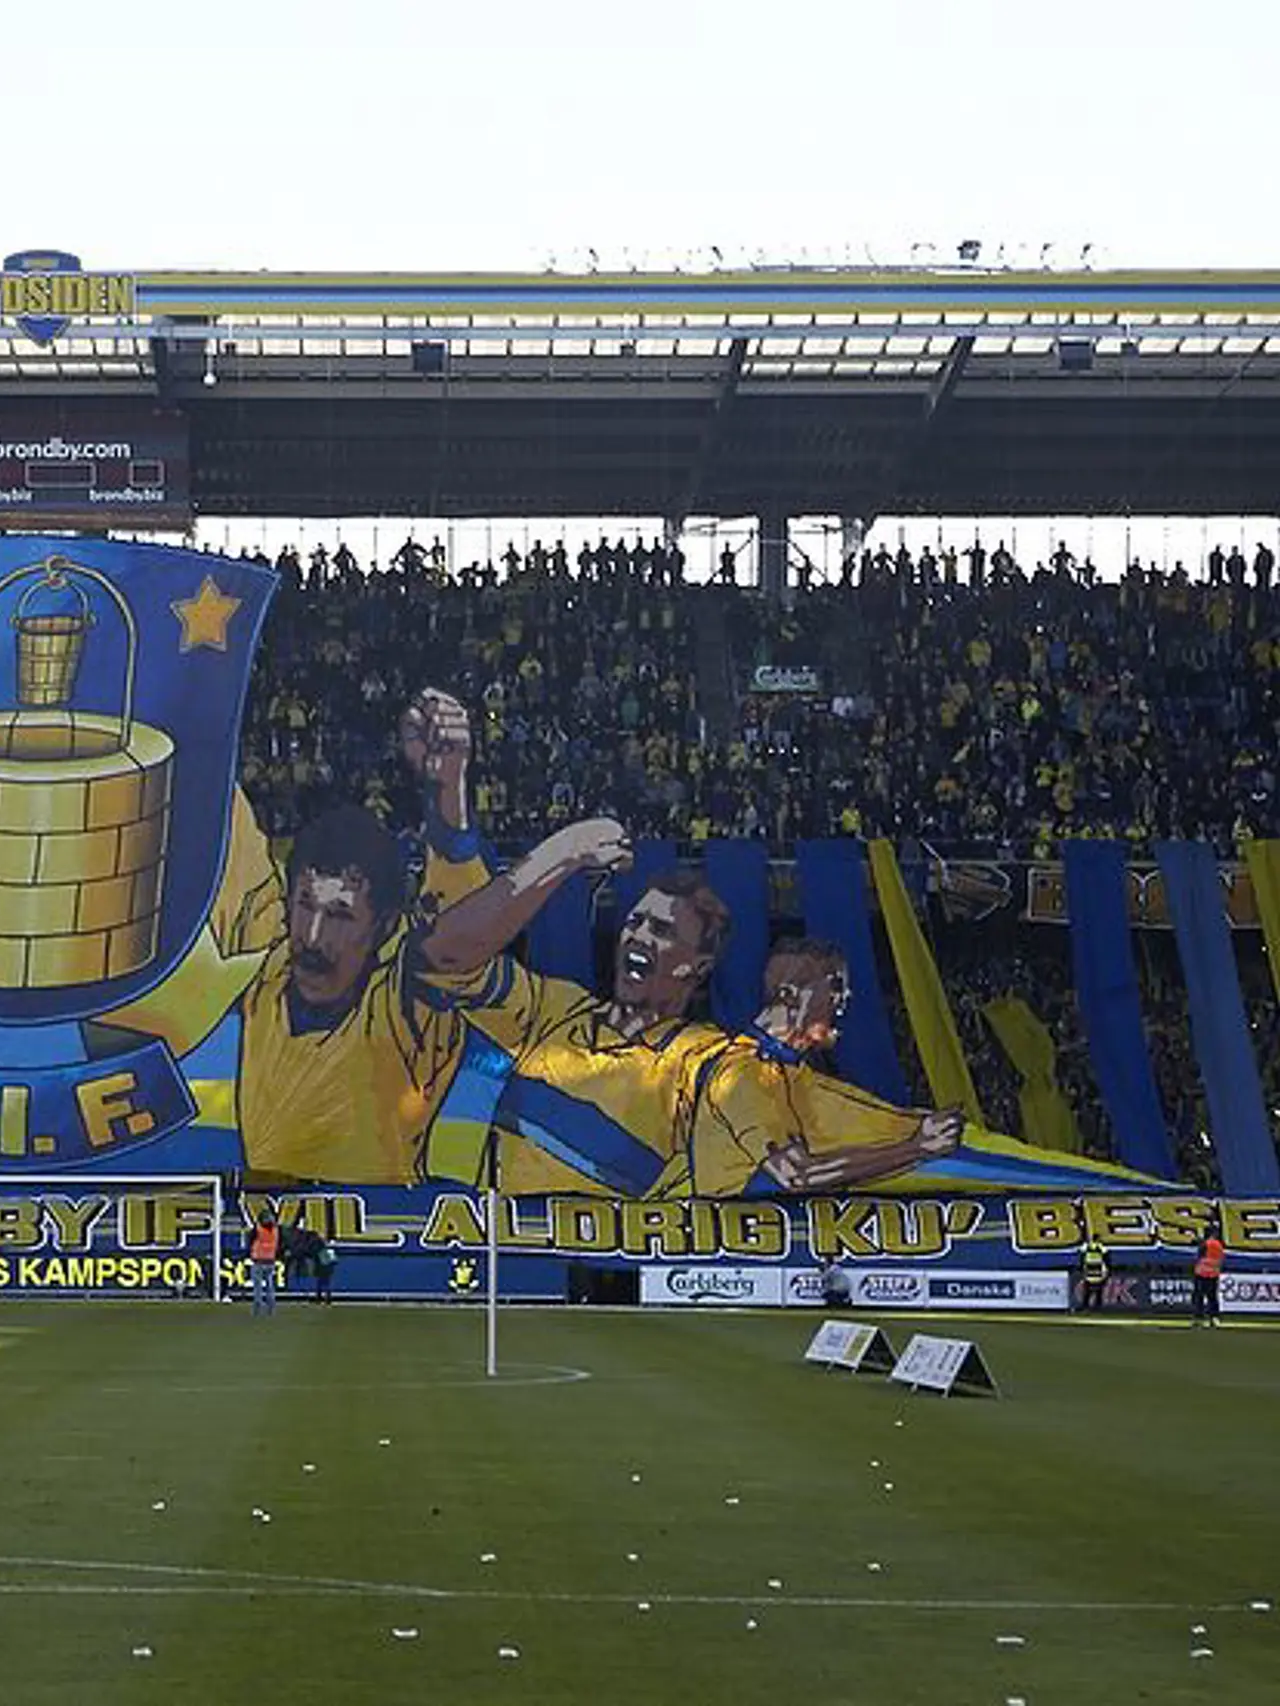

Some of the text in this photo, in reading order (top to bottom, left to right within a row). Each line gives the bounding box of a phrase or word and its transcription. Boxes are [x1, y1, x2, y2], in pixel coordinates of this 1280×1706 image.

[122, 1195, 214, 1249] IF
[423, 1196, 790, 1258] ALDRIG
[666, 1270, 755, 1298] Carlsberg
[946, 1282, 1011, 1297] Danske
